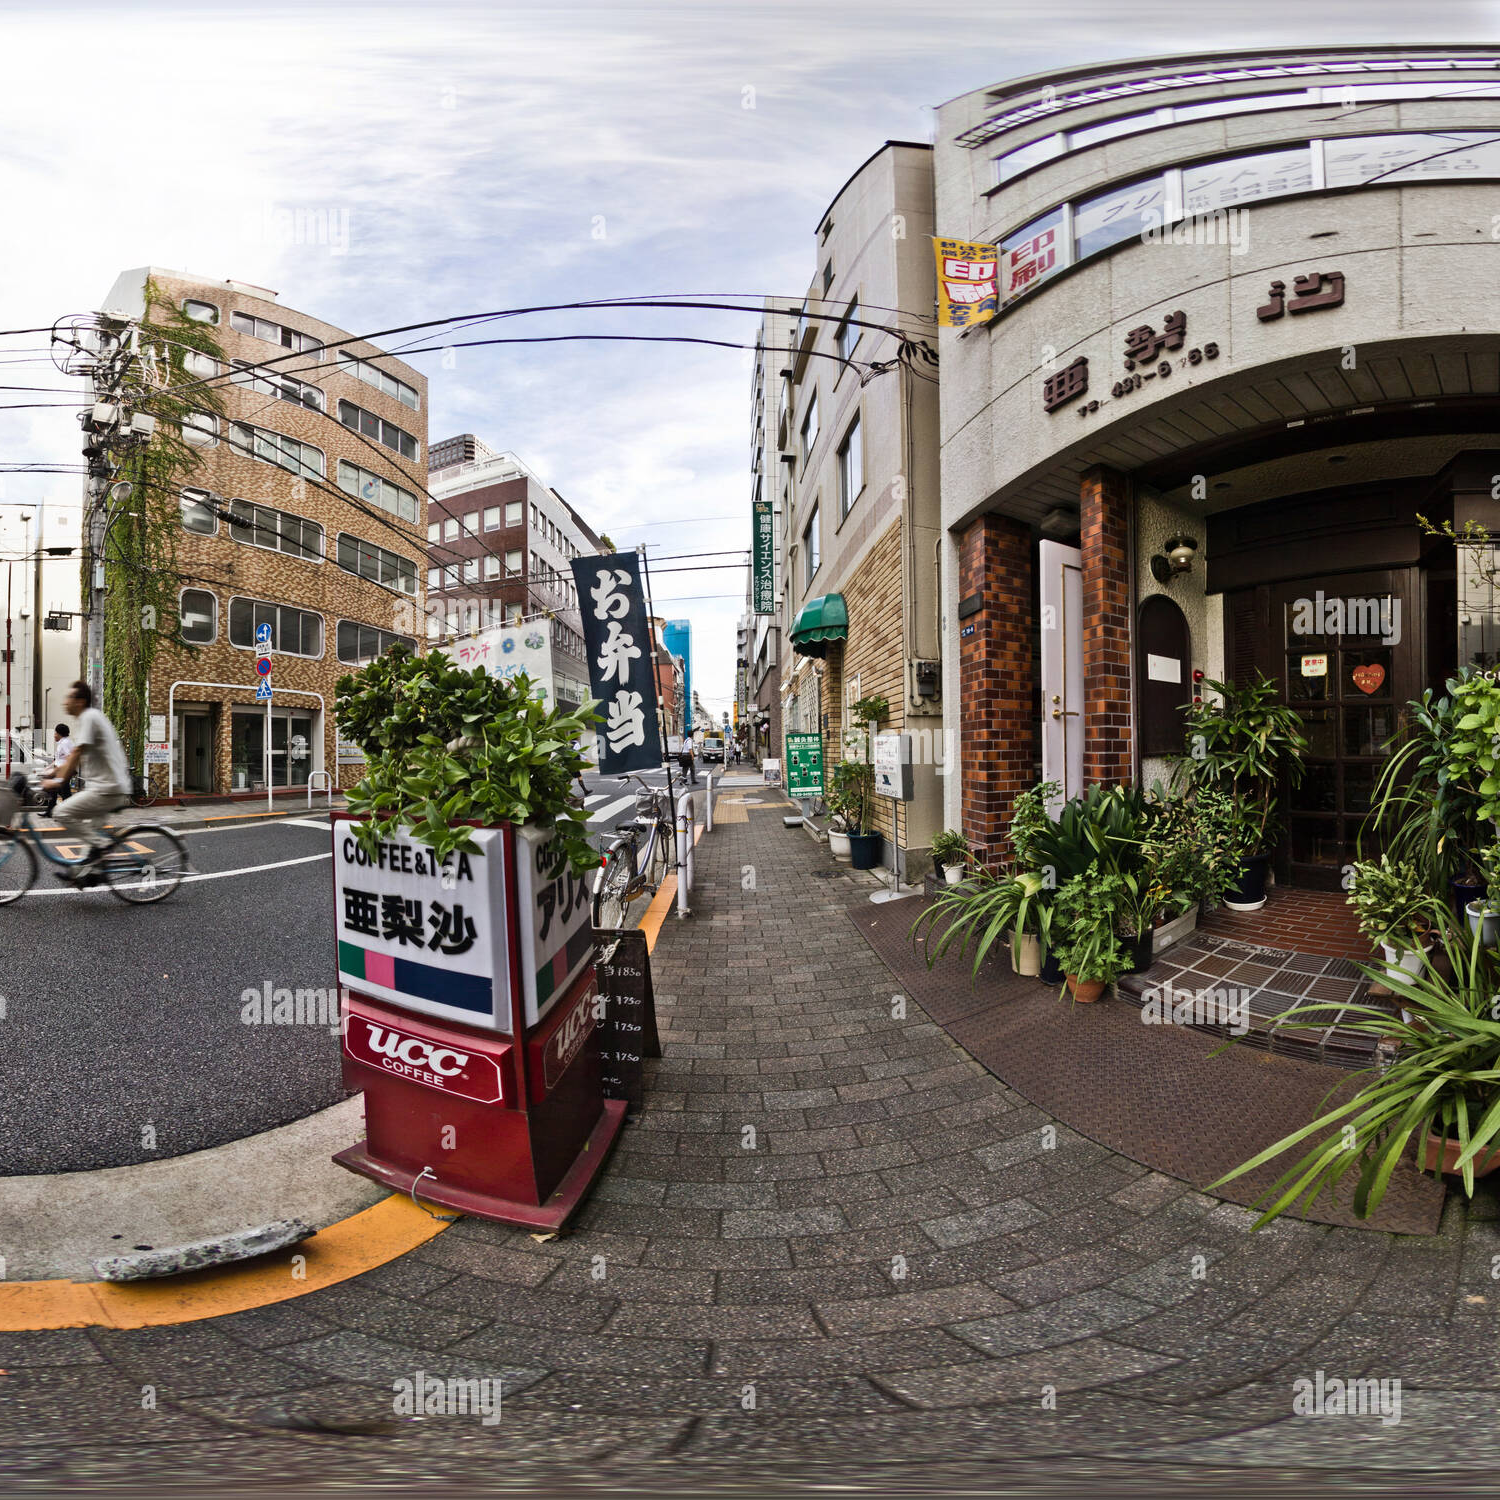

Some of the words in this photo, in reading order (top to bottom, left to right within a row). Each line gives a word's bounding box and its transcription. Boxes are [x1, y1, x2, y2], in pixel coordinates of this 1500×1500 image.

[945, 259, 996, 303] 印刷
[1009, 228, 1055, 291] 印刷
[760, 514, 773, 612] 健康サイエンス治療院
[459, 641, 491, 663] ランチ
[590, 569, 645, 754] お弁当
[342, 887, 477, 955] 亜梨沙
[382, 1057, 444, 1087] COFFEE
